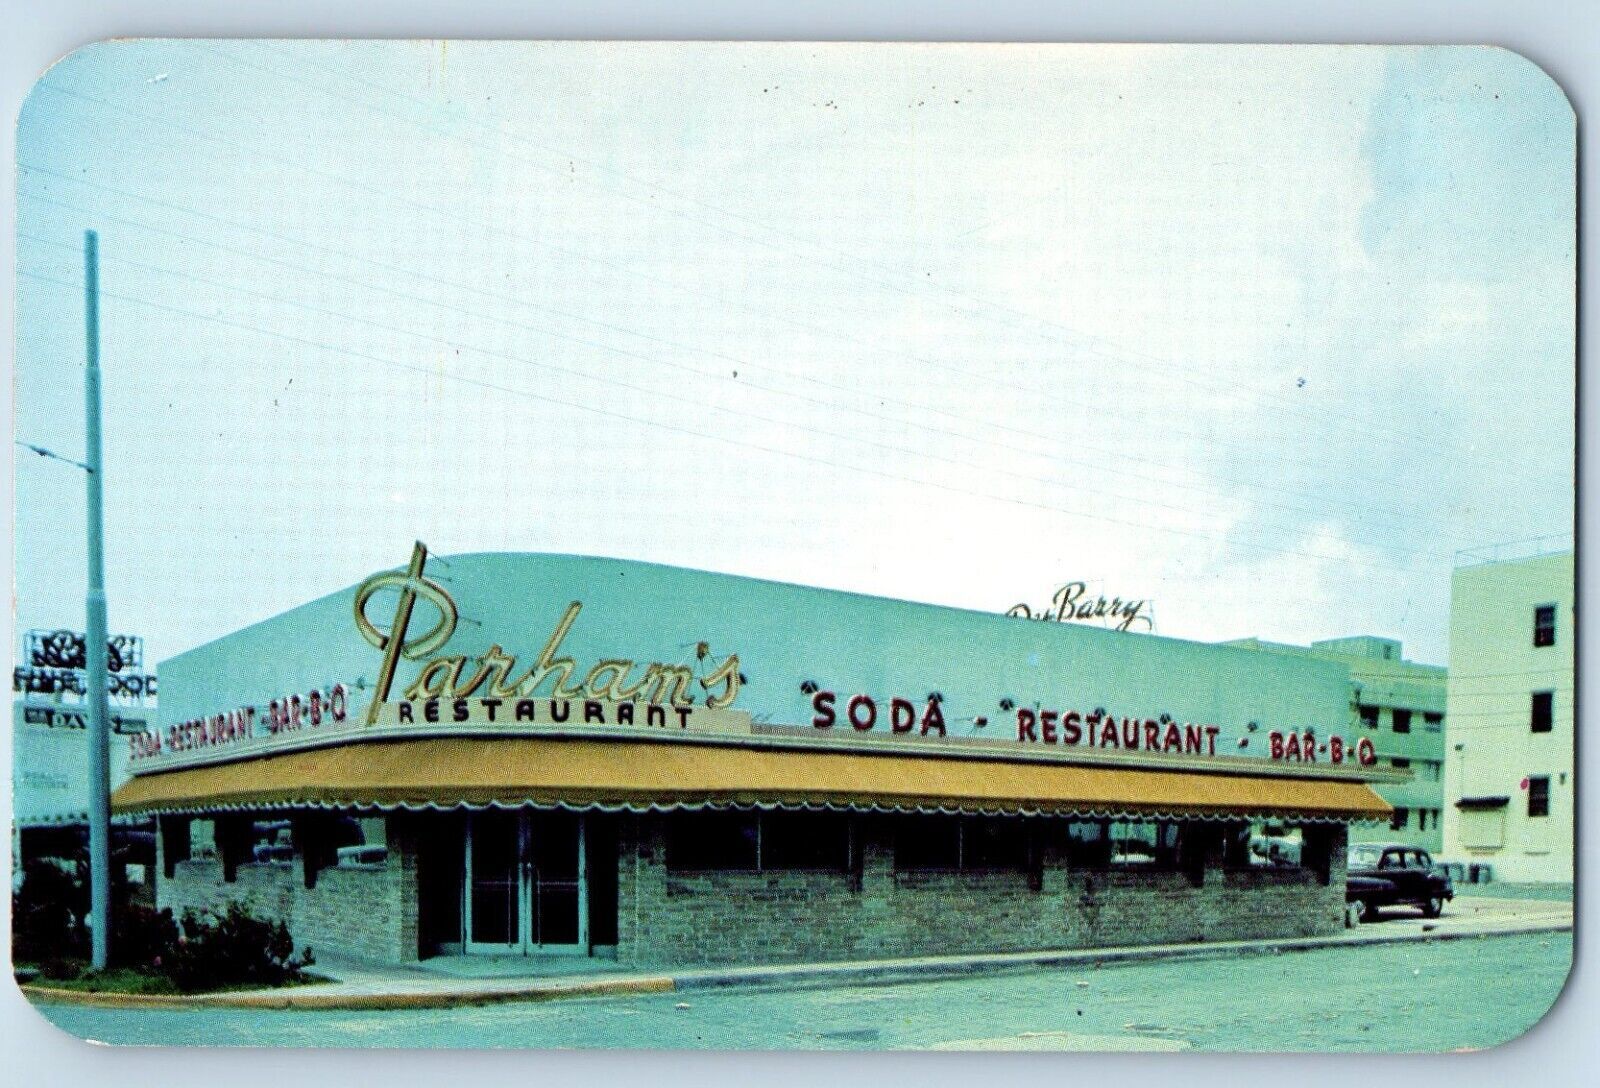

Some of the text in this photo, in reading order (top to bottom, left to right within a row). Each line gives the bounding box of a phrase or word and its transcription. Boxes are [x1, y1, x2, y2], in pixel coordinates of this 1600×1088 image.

[1052, 581, 1153, 632] Barry
[353, 540, 741, 728] Parham's
[170, 705, 255, 752] RESTAURANT
[399, 699, 693, 729] RESTAURANT
[811, 690, 947, 738] SODA
[1016, 707, 1220, 756] RESTAURANT
